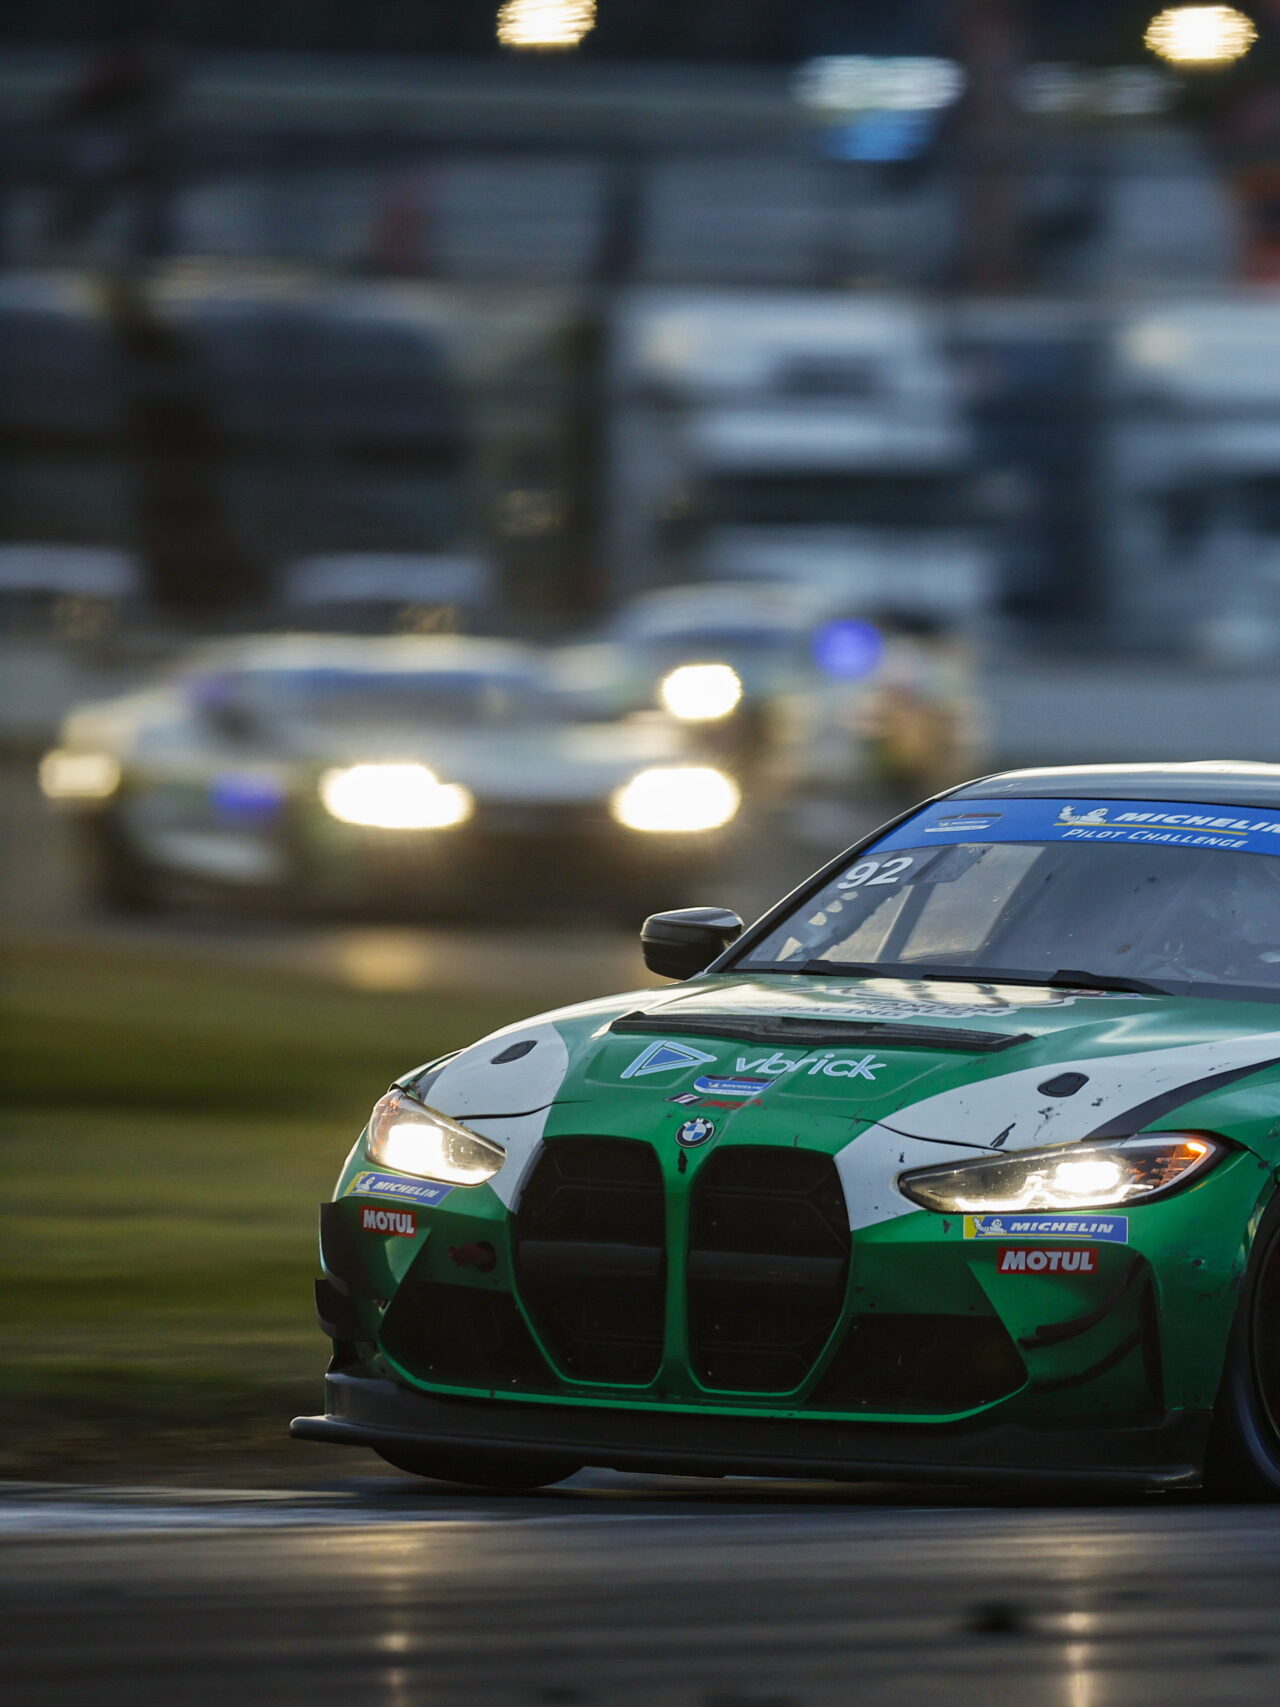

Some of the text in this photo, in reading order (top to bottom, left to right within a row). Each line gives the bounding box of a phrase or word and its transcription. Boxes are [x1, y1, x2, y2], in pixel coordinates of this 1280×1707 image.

[1061, 828, 1249, 849] PILOT CHALLENGE
[836, 856, 914, 890] 92
[735, 1052, 888, 1081] vbrick
[372, 1181, 440, 1199] MICHELIN
[362, 1209, 415, 1234] MOTUL
[1010, 1221, 1114, 1234] MICHELIN
[1001, 1250, 1094, 1271] MOTUL
